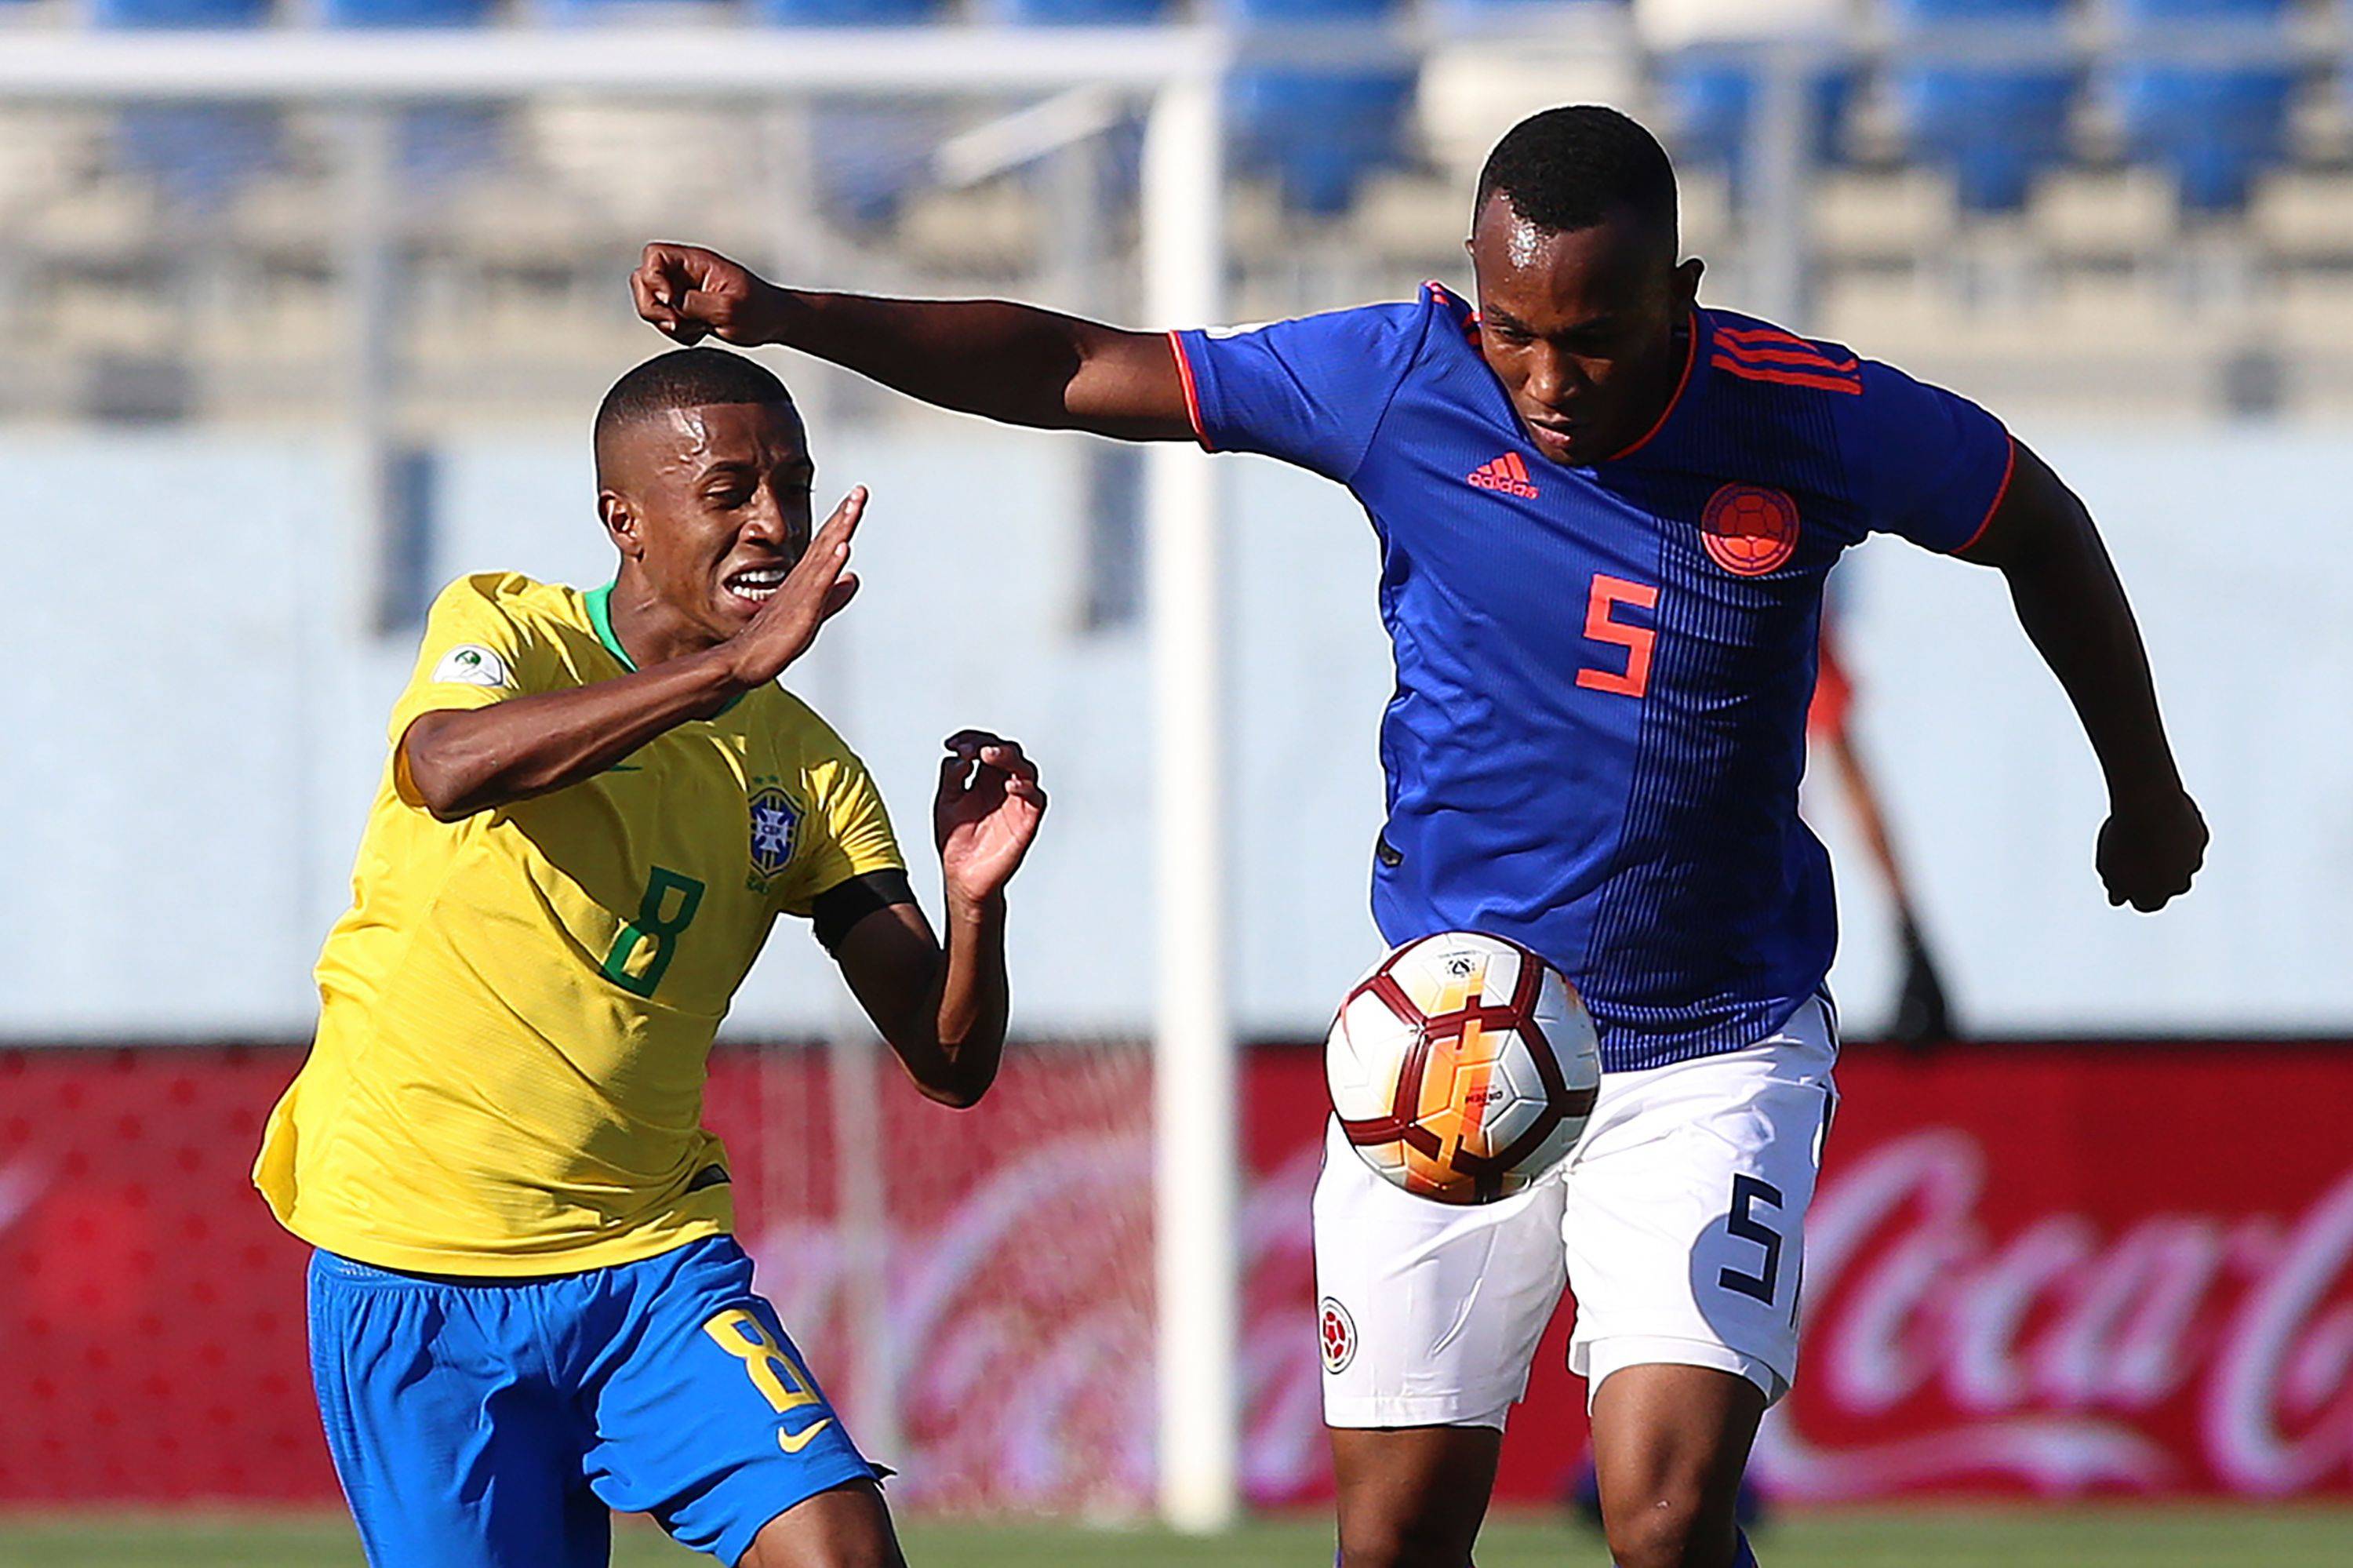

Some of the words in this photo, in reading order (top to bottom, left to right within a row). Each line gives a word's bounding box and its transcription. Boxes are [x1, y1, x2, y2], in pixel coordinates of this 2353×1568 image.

[1467, 472, 1538, 499] adidas
[1575, 573, 1658, 698] 5
[598, 865, 706, 999] 8
[1718, 1173, 1784, 1307] 5
[703, 1308, 822, 1413] 8
